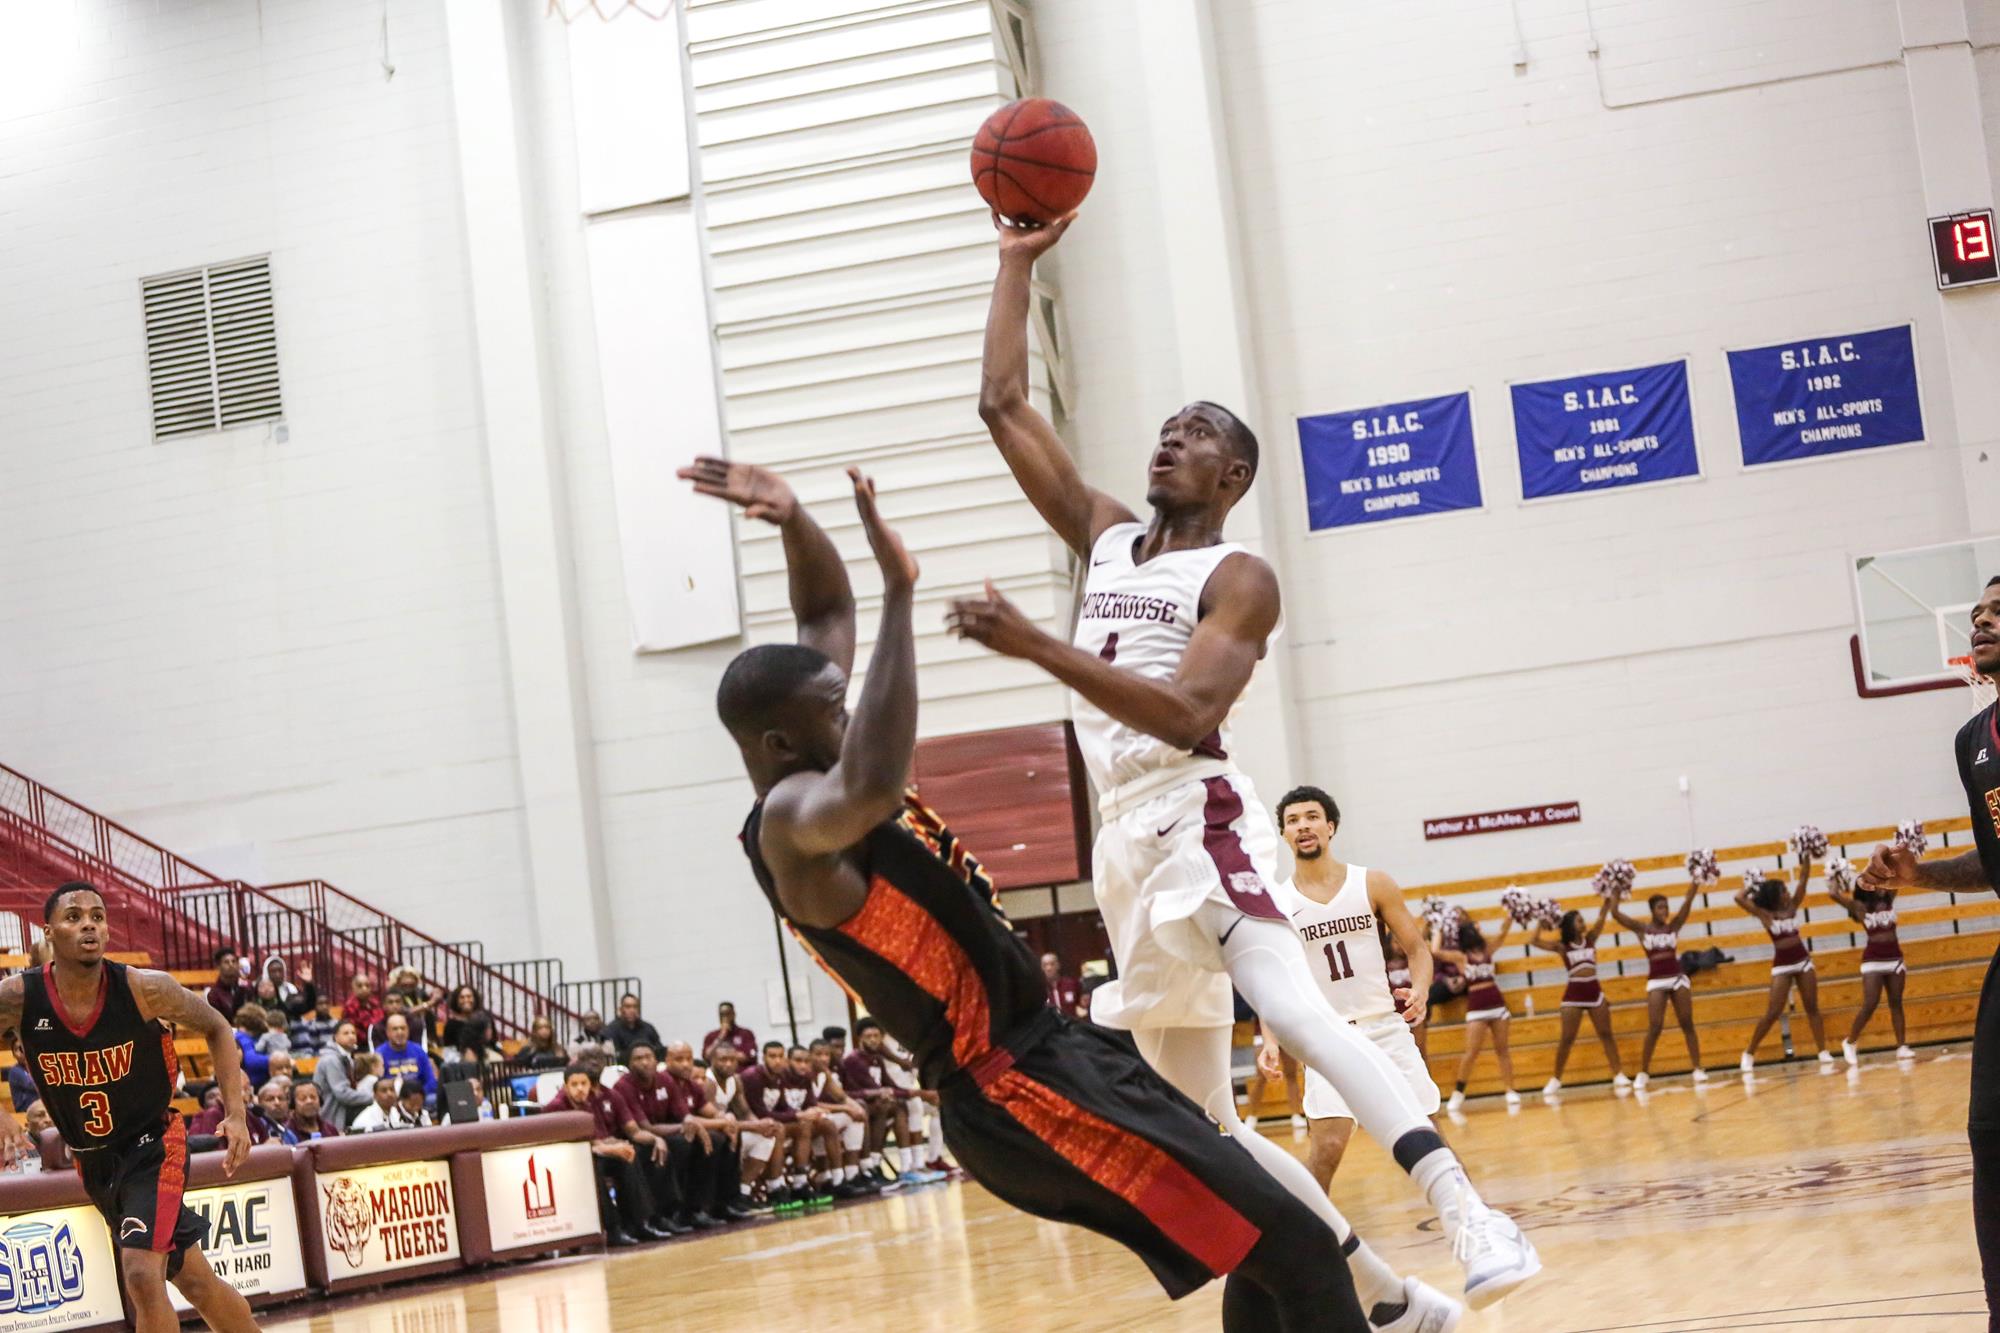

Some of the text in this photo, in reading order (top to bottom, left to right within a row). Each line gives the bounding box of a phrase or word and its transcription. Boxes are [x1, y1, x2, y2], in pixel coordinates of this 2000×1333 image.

[1954, 220, 1990, 261] 13
[1781, 342, 1861, 370] S.I.A.C.
[1807, 374, 1842, 392] 1992
[1352, 411, 1424, 440] S.I.A.C.
[1773, 398, 1883, 426] MEN'S ALL-SPORTS
[1801, 423, 1862, 444] CHAMPIONS
[1367, 442, 1411, 467] 1990
[1554, 435, 1659, 463] MEN'S ALL-SPORTS
[1340, 466, 1440, 494] MEN'S ALL-SPORTS
[1580, 462, 1638, 483] CHAMPIONS
[1364, 491, 1420, 512] CHAMPIONS
[1426, 821, 1464, 836] Arthur
[1465, 818, 1477, 831] J.
[1528, 810, 1543, 823] Jr.
[1545, 806, 1578, 821] Court
[1300, 914, 1372, 942] OREHOUSE
[1323, 940, 1355, 982] 11
[38, 1041, 134, 1087] SHAW
[79, 1090, 114, 1137] 3
[405, 1168, 414, 1180] OF
[369, 1180, 450, 1225] MAROON
[188, 1195, 268, 1251] IAC
[379, 1218, 448, 1262] TIGERS
[214, 1253, 271, 1276] AY HARD
